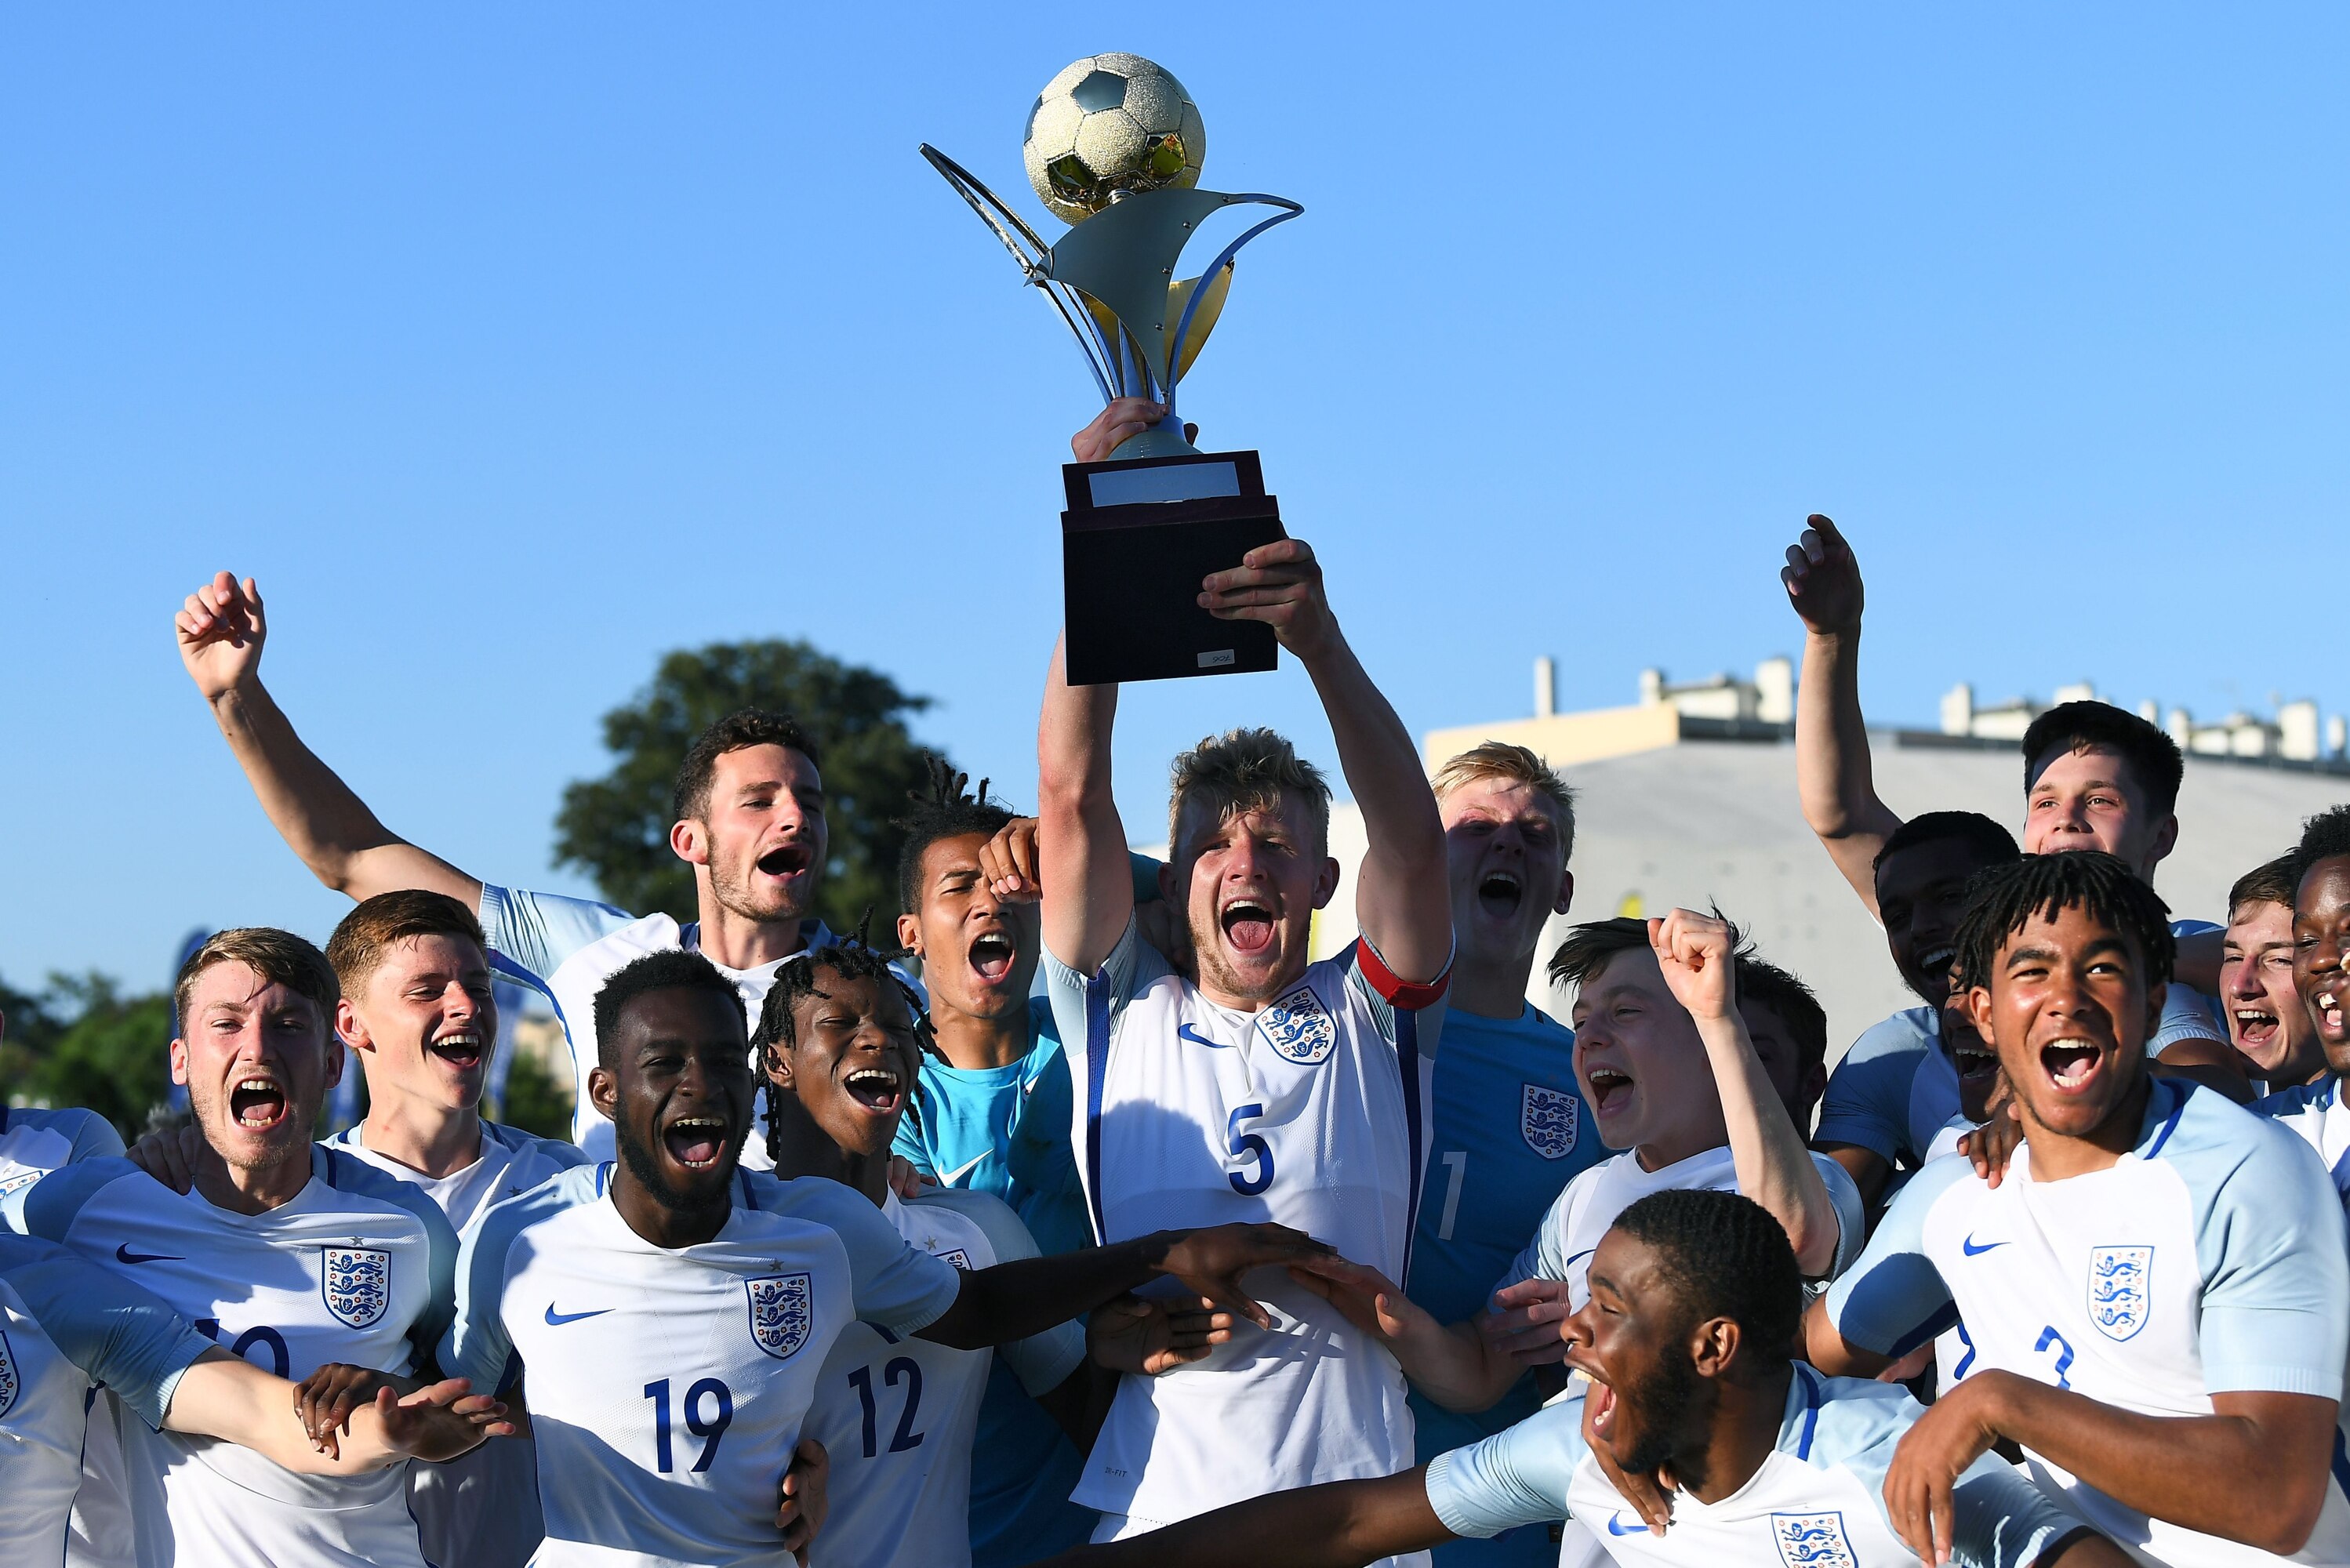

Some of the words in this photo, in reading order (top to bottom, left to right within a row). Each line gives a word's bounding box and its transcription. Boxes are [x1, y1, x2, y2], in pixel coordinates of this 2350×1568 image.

[1228, 1103, 1274, 1196] 5
[1438, 1152, 1466, 1240] 1
[645, 1377, 732, 1472] 19
[848, 1357, 924, 1458] 12
